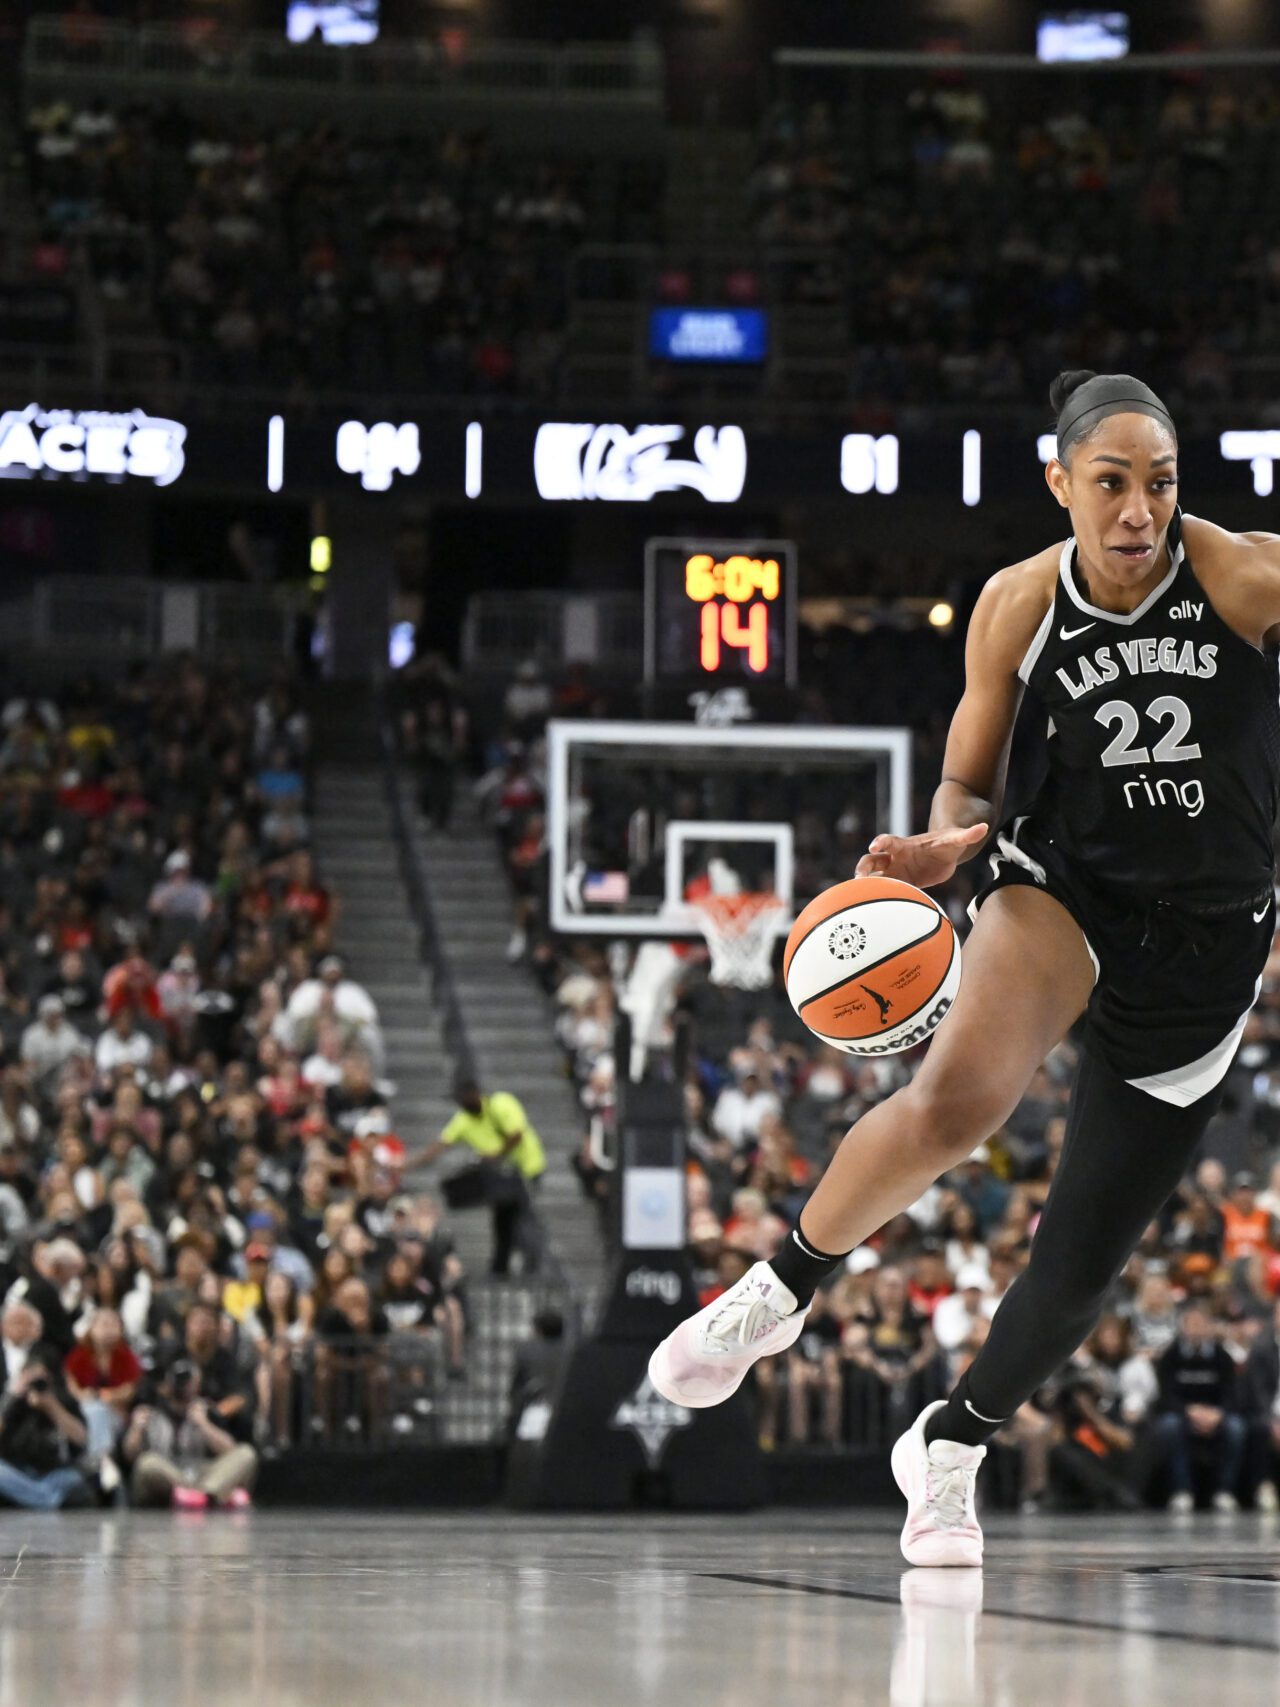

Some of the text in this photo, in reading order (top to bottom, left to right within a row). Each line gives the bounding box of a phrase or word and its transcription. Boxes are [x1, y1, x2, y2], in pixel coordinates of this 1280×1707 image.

[0, 421, 176, 477] ACES
[686, 555, 780, 602] 6:04
[701, 602, 769, 672] 14
[1169, 600, 1204, 622] ally
[1055, 637, 1219, 700] LAS VEGAS
[1094, 695, 1202, 767] 22
[1123, 774, 1205, 818] ring
[845, 997, 954, 1054] Wilson
[626, 1267, 682, 1305] ring
